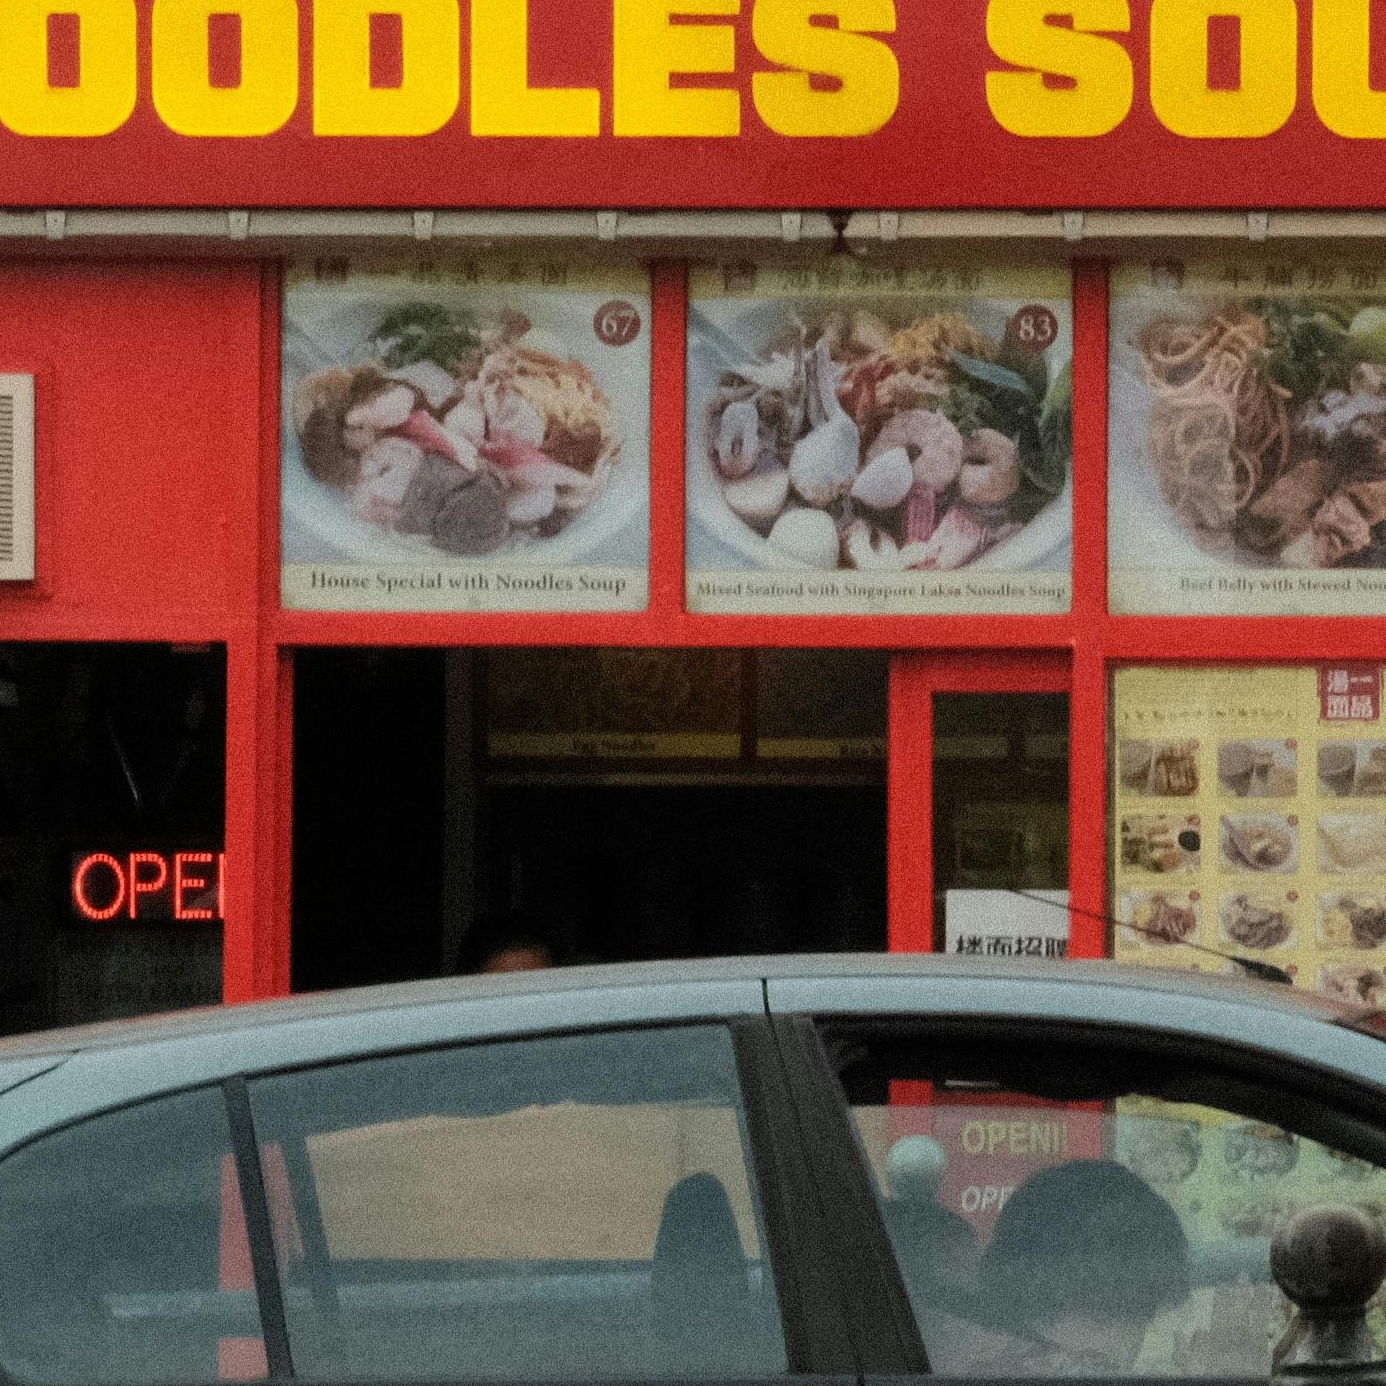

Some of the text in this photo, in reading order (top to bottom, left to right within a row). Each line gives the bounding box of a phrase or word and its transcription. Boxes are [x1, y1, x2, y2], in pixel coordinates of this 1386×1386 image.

[600, 311, 634, 338] 67
[1019, 313, 1052, 340] 83
[310, 572, 628, 597] House Special with Noodles Soup
[696, 582, 1066, 602] Mixed Seafood with Singapore Laksa Noodles Soup
[1179, 577, 1213, 593] Beef
[1218, 577, 1255, 595] Belly
[1259, 577, 1294, 593] with
[1298, 577, 1352, 593] Stewed
[72, 852, 224, 920] OPE
